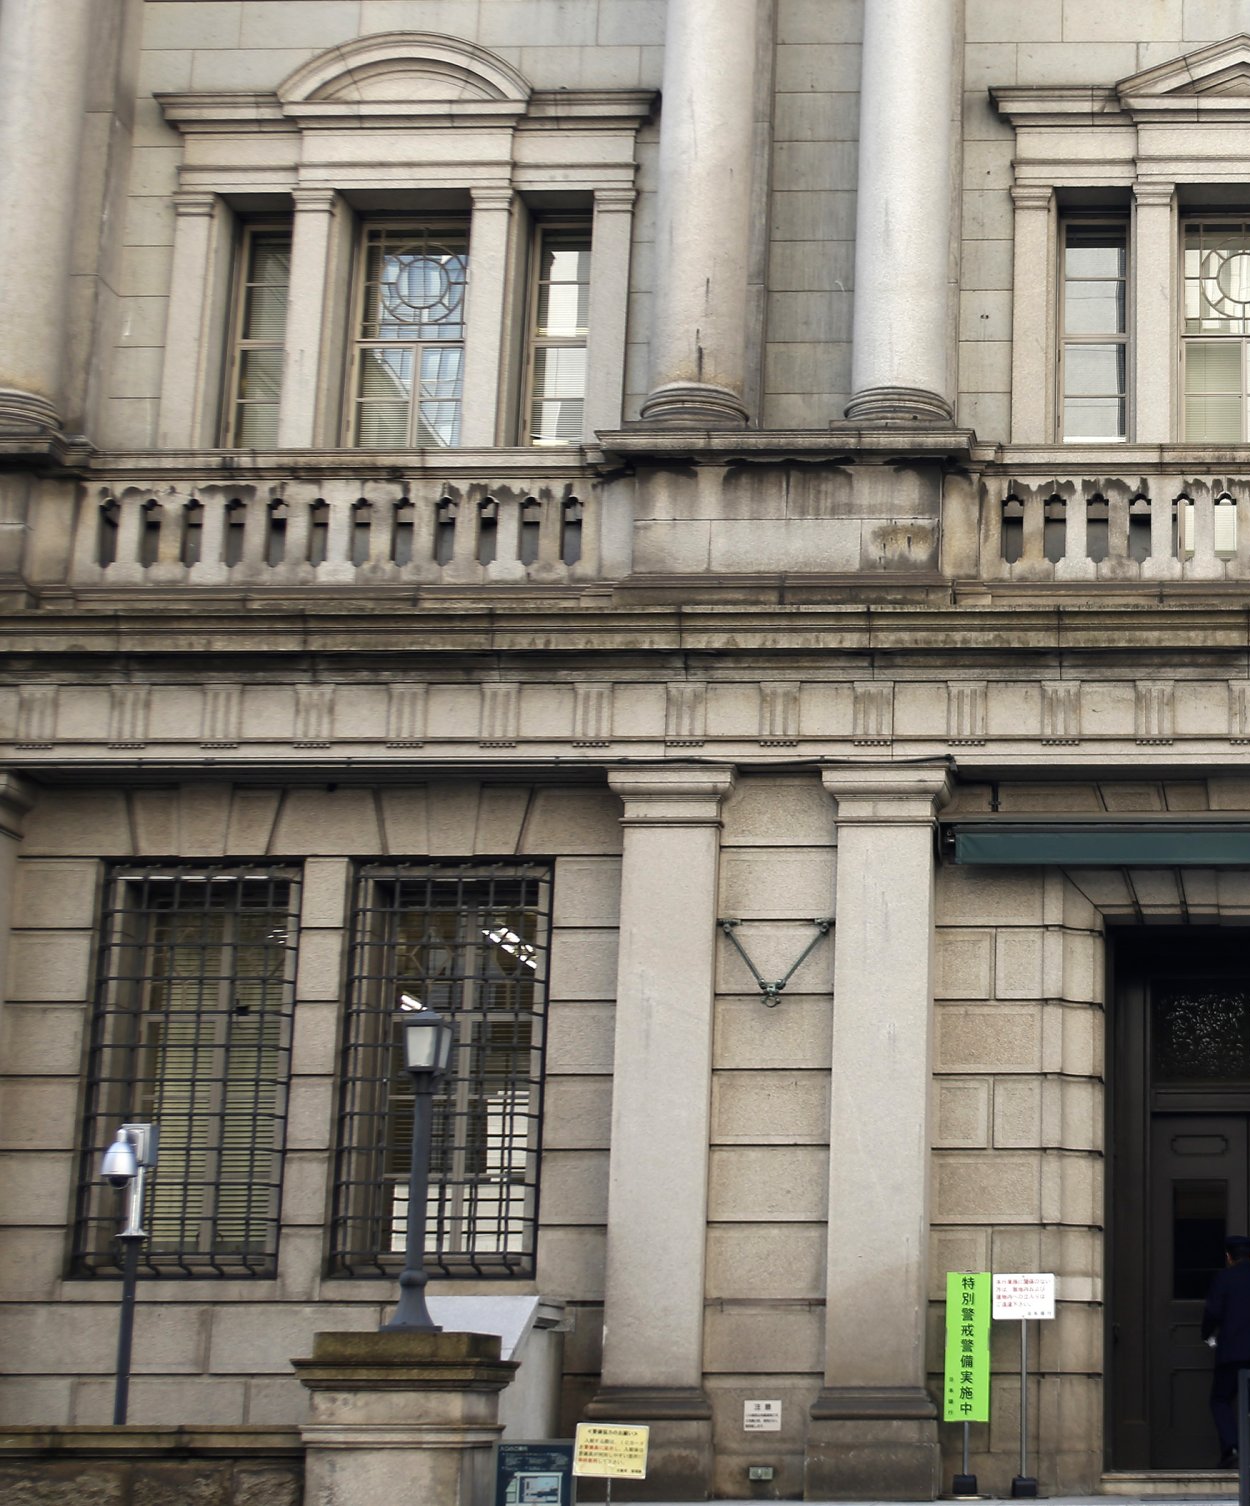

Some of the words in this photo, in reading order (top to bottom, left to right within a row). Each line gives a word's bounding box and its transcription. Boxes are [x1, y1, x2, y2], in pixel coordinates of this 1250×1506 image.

[959, 1276, 976, 1416] 特別警戒警備実施中
